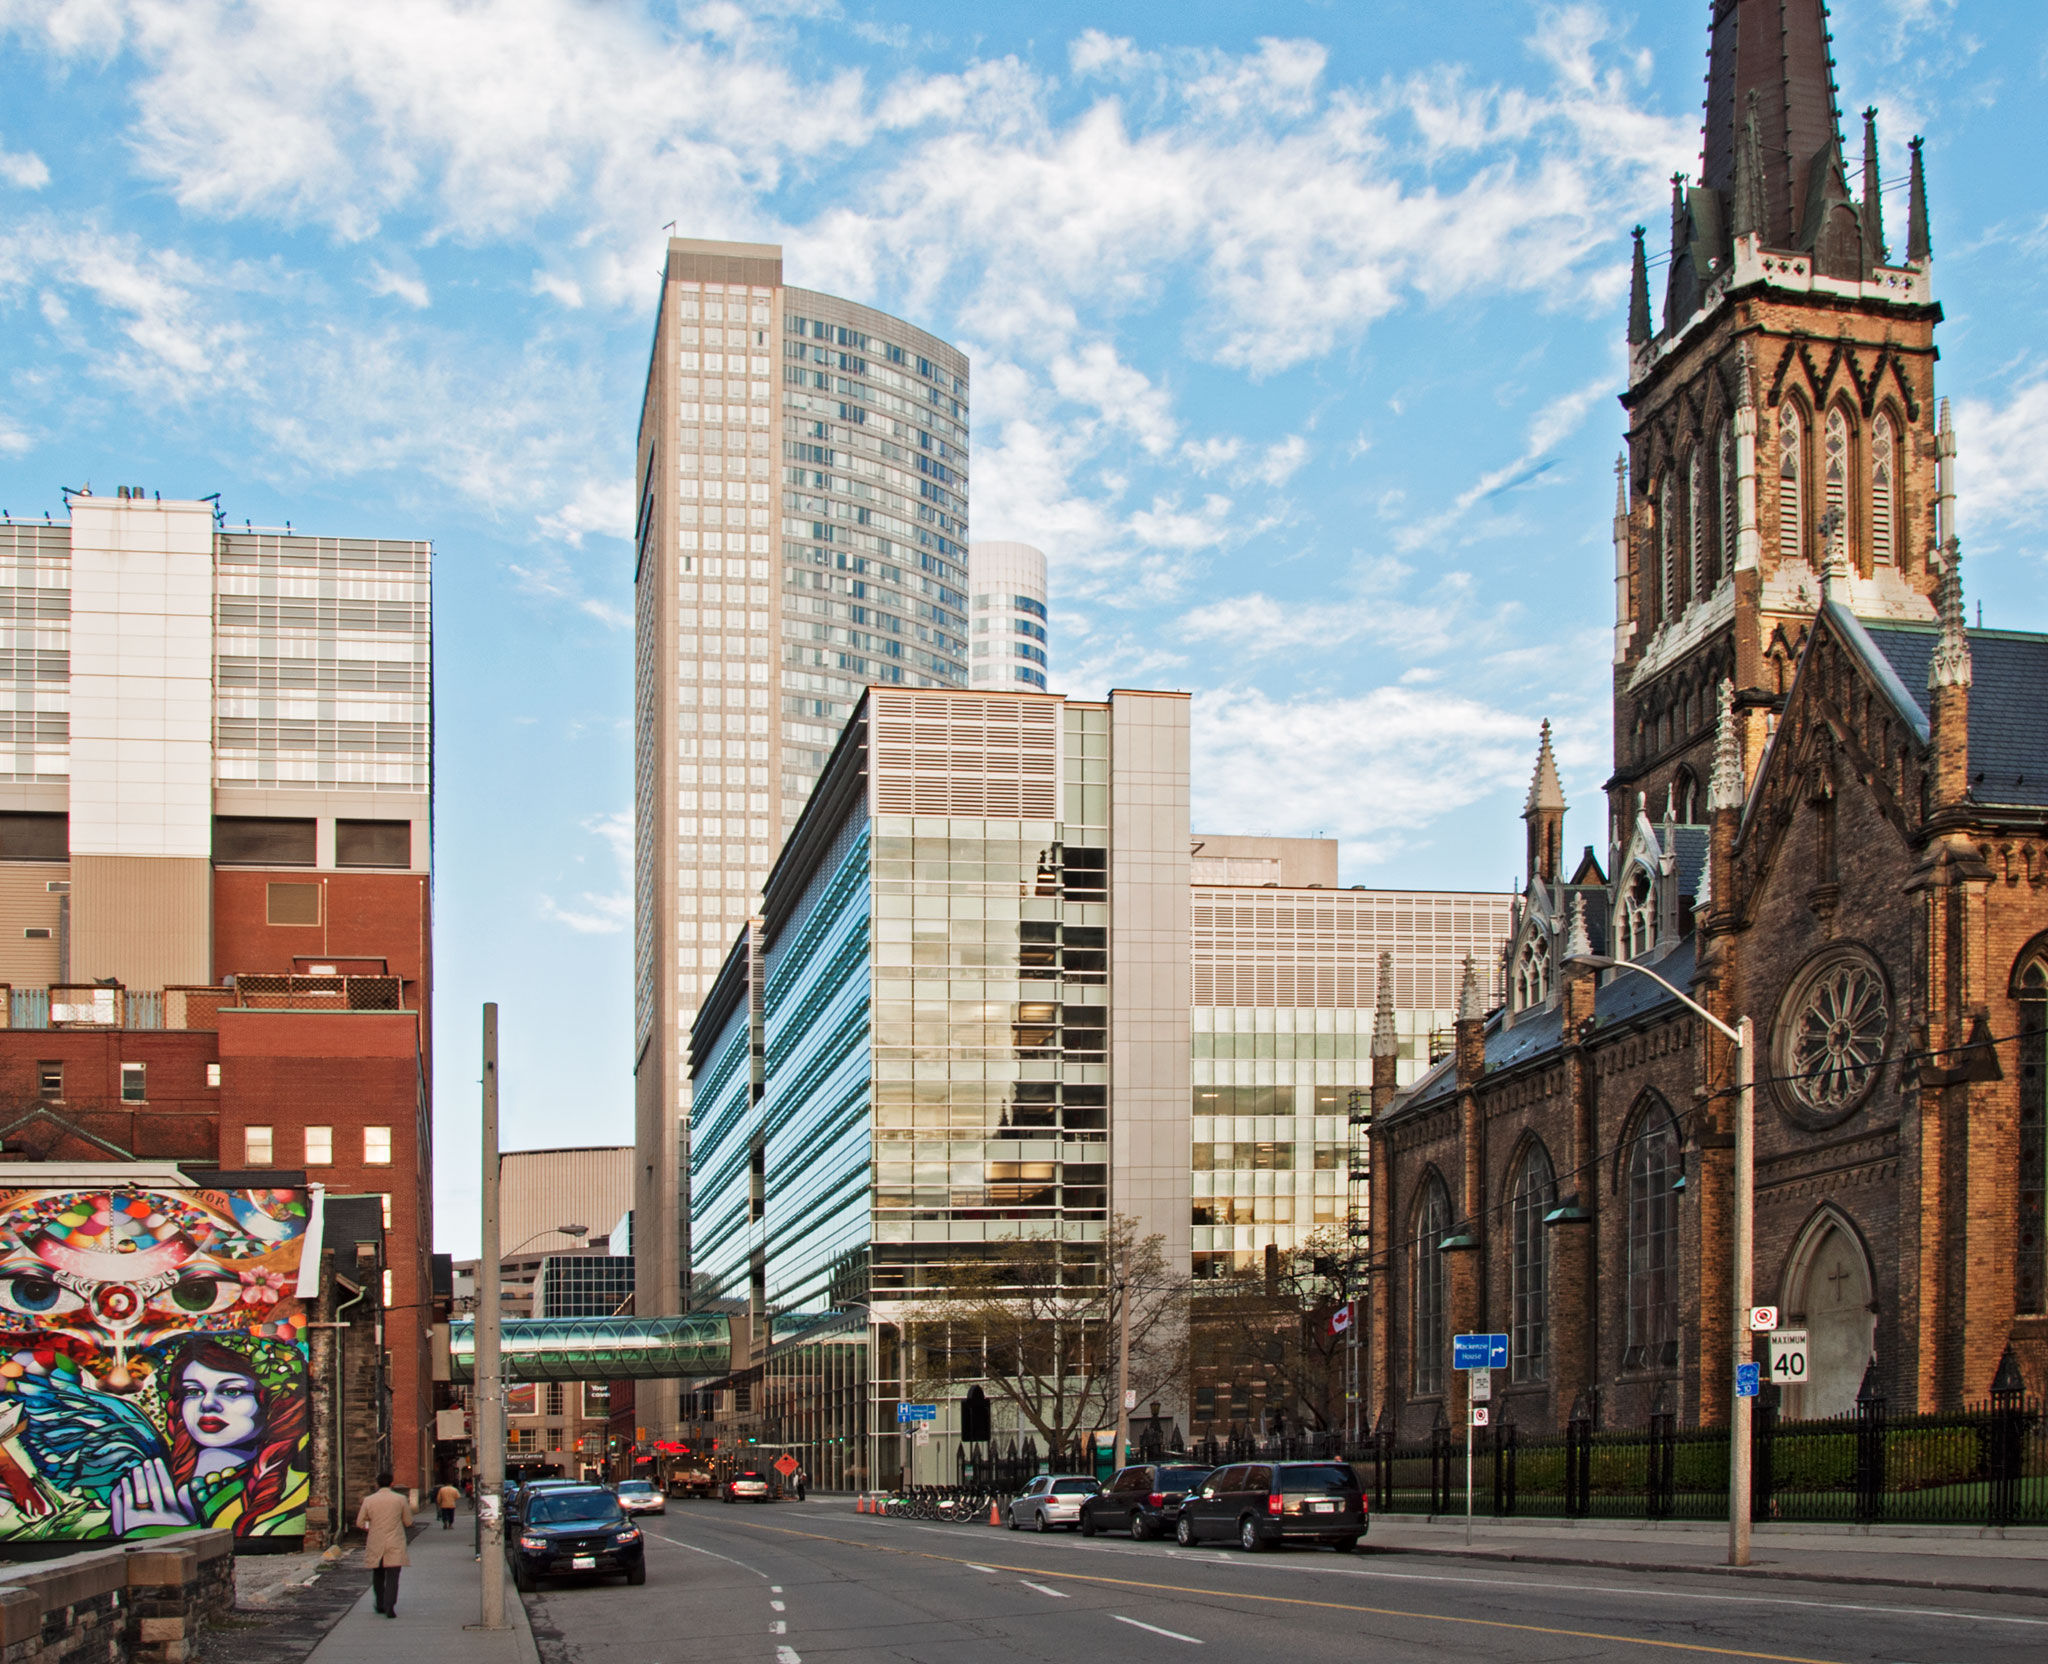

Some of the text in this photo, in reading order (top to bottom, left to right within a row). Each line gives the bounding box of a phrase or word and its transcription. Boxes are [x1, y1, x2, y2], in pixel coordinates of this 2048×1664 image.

[1771, 1335, 1806, 1344] MAXIMUM
[1774, 1352, 1805, 1376] 40
[900, 1404, 909, 1413] H
